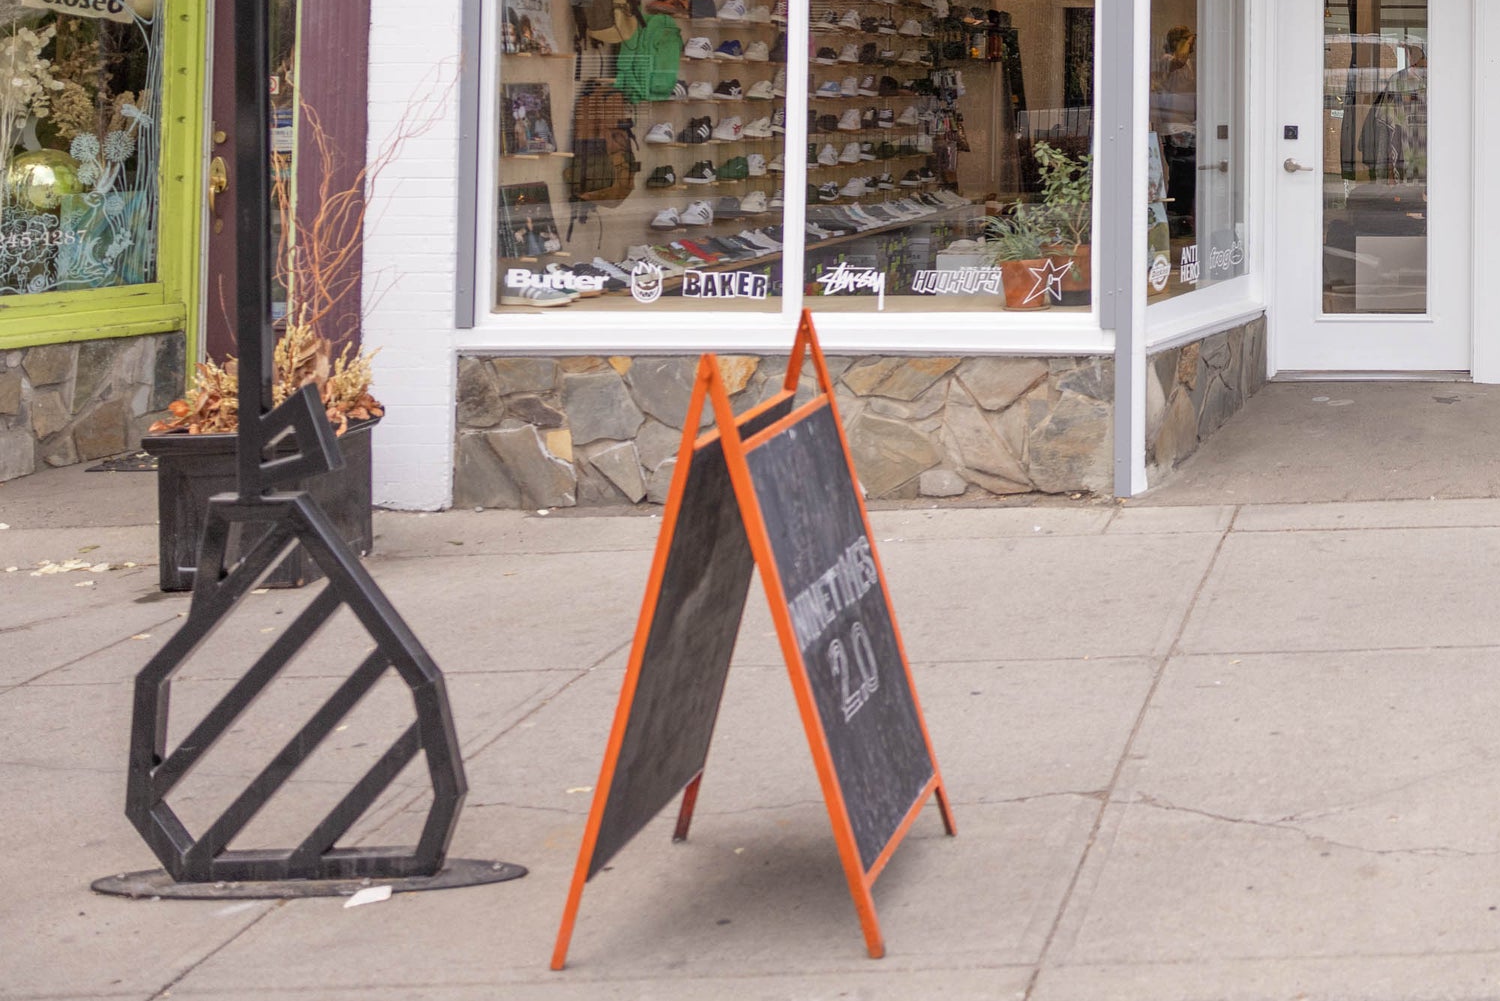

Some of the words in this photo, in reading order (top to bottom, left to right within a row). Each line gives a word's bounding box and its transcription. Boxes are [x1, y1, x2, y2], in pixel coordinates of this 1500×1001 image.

[1181, 245, 1199, 264] ANTI
[507, 265, 610, 290] Butter
[683, 269, 768, 299] BAKER
[1180, 261, 1200, 284] HERO
